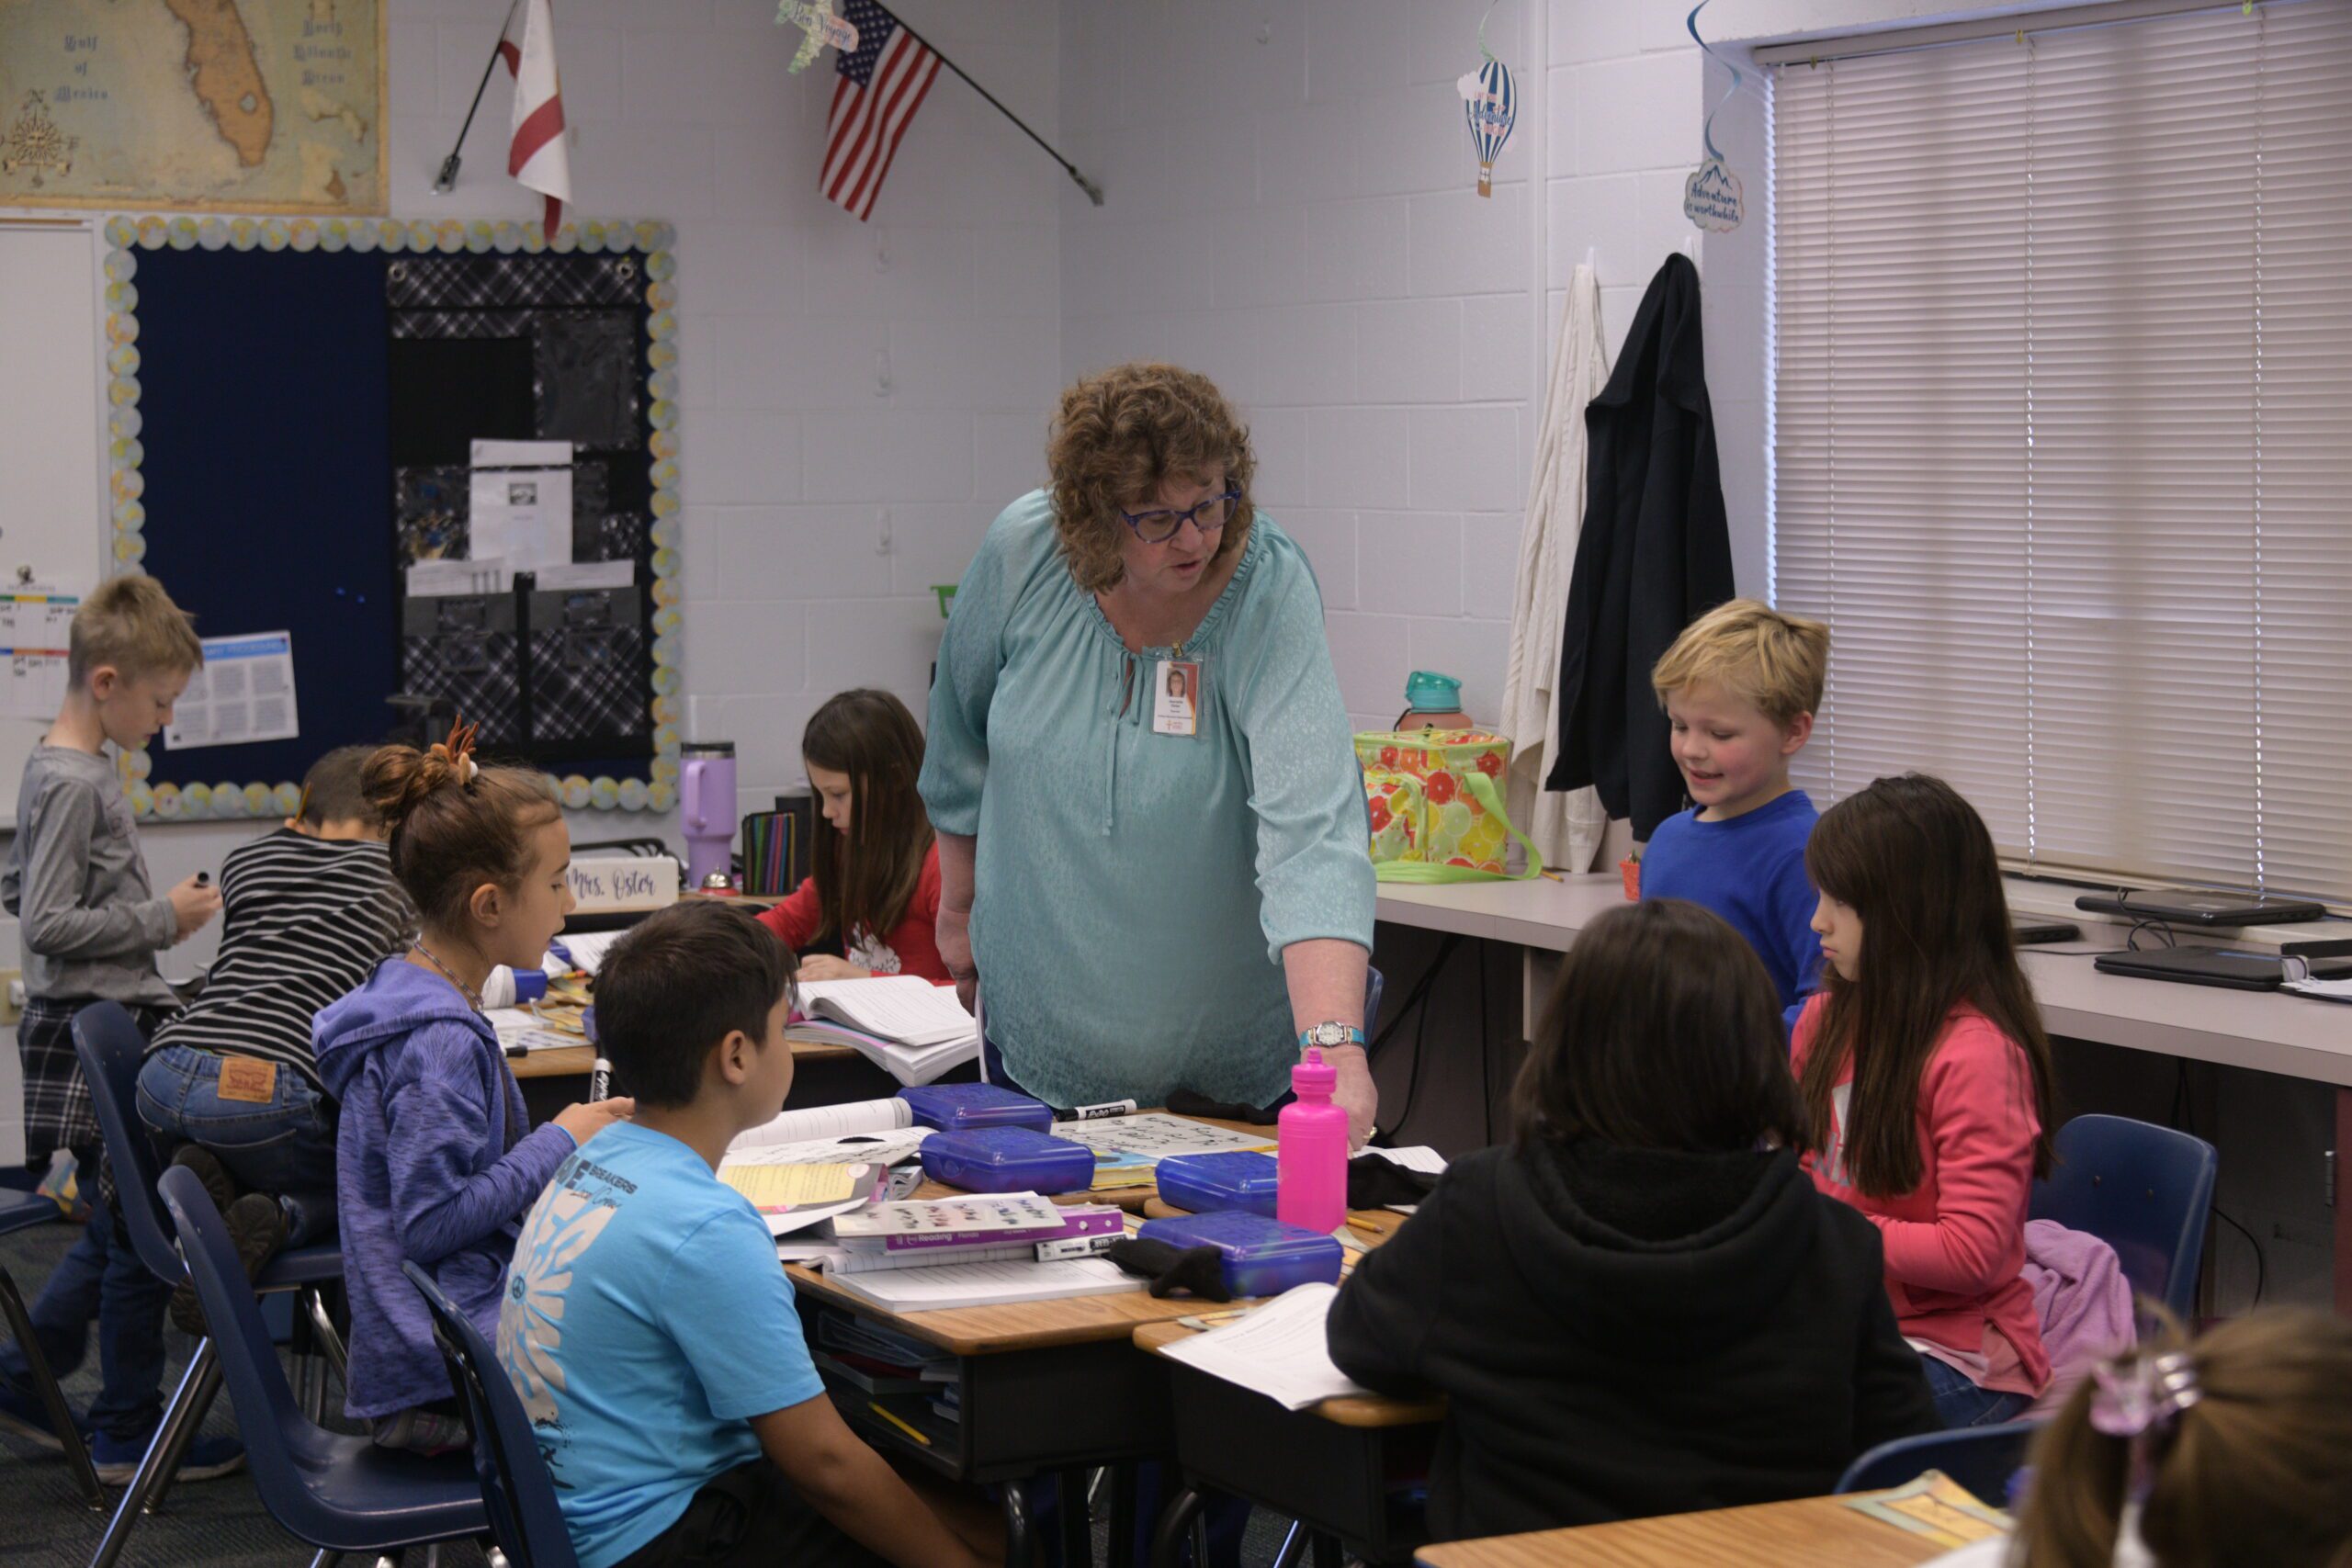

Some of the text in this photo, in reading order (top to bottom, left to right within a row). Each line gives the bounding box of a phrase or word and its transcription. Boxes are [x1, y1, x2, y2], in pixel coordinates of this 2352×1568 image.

[1690, 182, 1738, 207] Adventure
[565, 868, 657, 900] Mrs. Oster
[588, 1165, 639, 1195] BREAKERS
[919, 1232, 953, 1242] Reading
